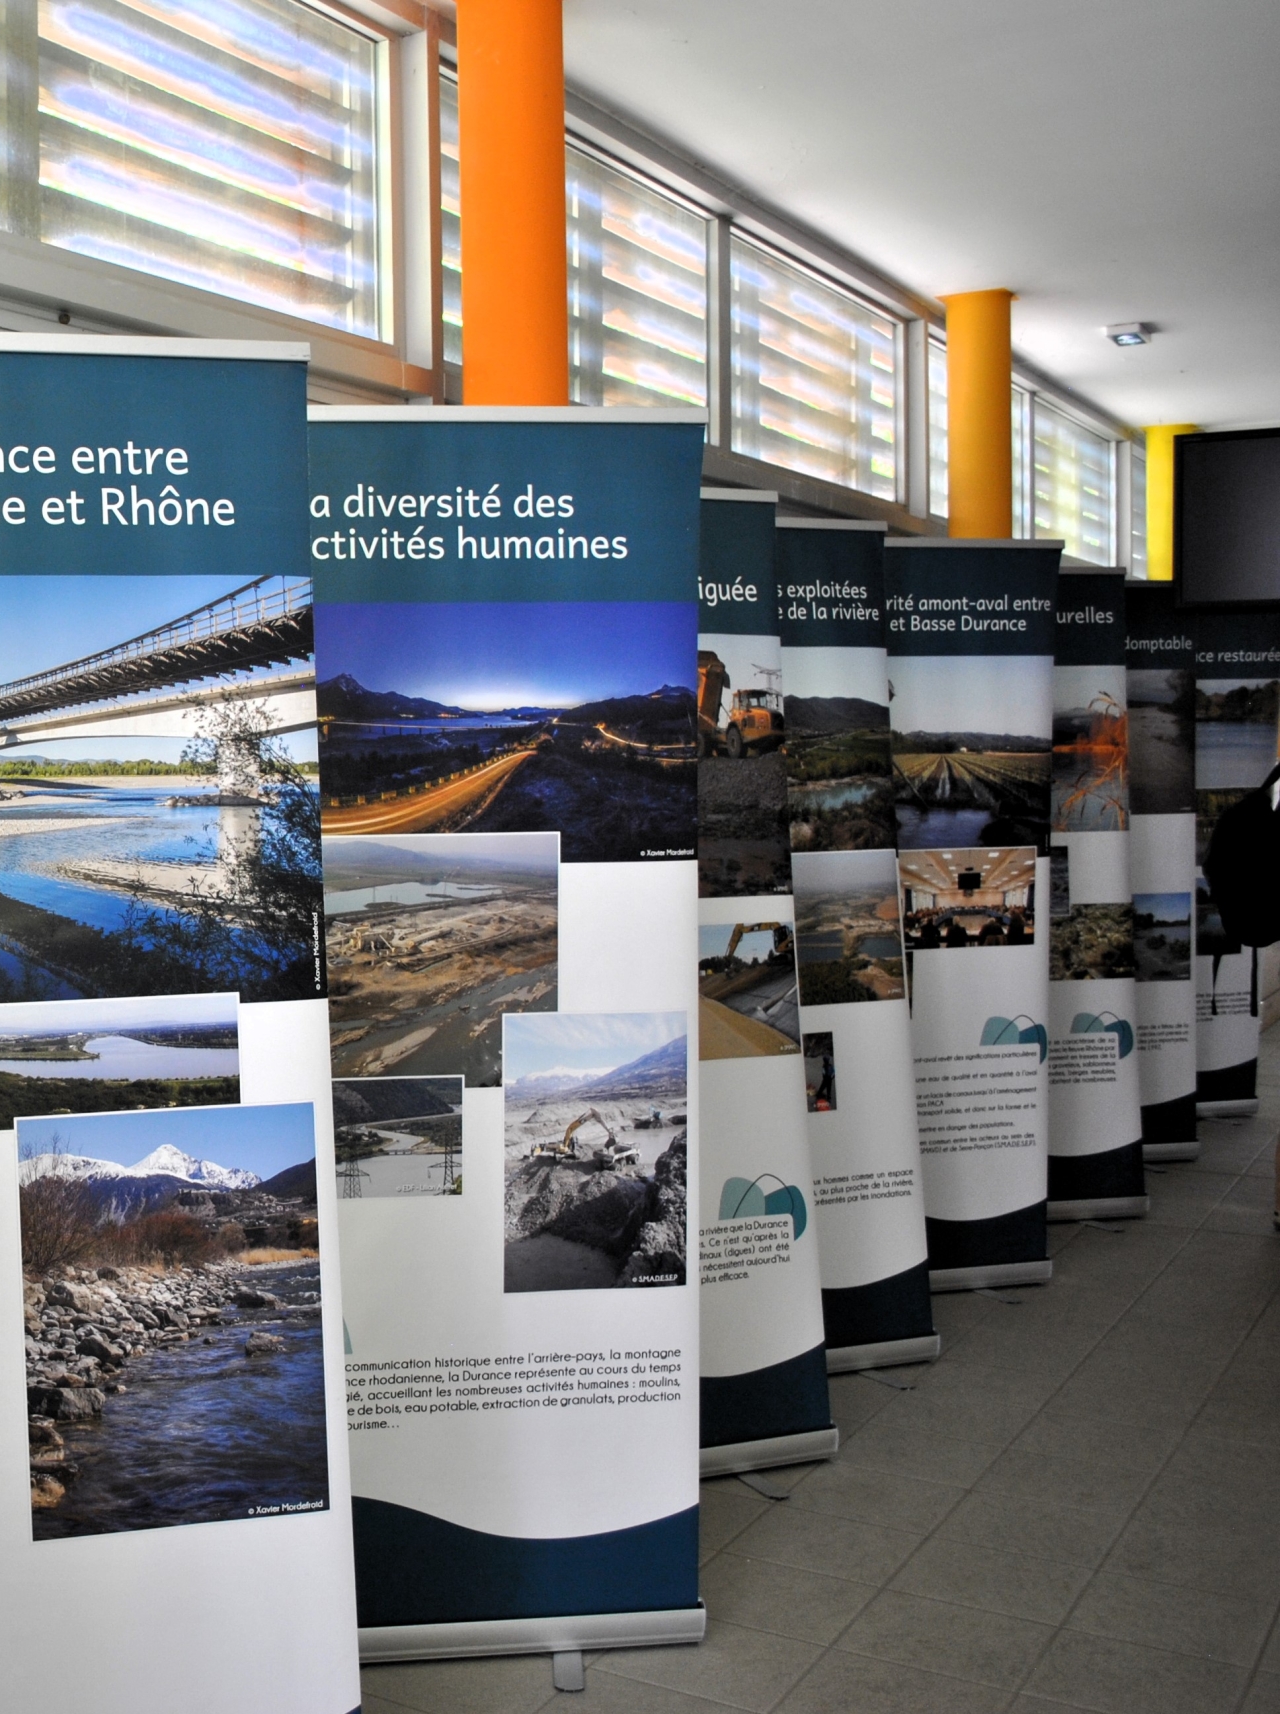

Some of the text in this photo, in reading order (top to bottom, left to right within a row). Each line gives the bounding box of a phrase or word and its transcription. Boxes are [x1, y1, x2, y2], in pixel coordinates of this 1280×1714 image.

[72, 441, 188, 475] entre
[42, 491, 86, 525] et
[101, 485, 235, 526] Rhône
[310, 484, 574, 518] a diversité des
[310, 525, 628, 560] ctivités humaines
[698, 576, 757, 606] iguée
[787, 580, 867, 602] exploitées
[788, 602, 807, 620] de
[812, 601, 827, 620] la
[832, 602, 879, 621] rivière
[886, 594, 1051, 611] rité amont-aval entre
[890, 615, 1026, 631] et Basse Durance
[1056, 606, 1114, 624] urelles
[1218, 647, 1280, 662] restaurée
[705, 1226, 728, 1236] rivière
[729, 1224, 744, 1234] que
[744, 1222, 752, 1230] la
[753, 1220, 788, 1230] Durance
[708, 1231, 789, 1247] Ce n'est qu'après la
[724, 1245, 755, 1257] (digues)
[758, 1244, 772, 1253] ont
[775, 1242, 790, 1252] été
[703, 1254, 790, 1272] nécessitent aujourd'hui
[700, 1272, 749, 1286] plus efficace.
[344, 1349, 681, 1372] communication historique entre l'arrière-pays, la montagne
[369, 1373, 444, 1386] rhodanienne,
[448, 1371, 460, 1382] la
[462, 1370, 512, 1382] Durance
[514, 1367, 576, 1380] représente
[579, 1368, 594, 1376] au
[596, 1366, 628, 1375] cours
[631, 1363, 646, 1374] du
[649, 1364, 681, 1374] temps
[367, 1387, 432, 1400] accueillant
[436, 1386, 452, 1397] les
[455, 1384, 522, 1396] nombreuses
[526, 1381, 574, 1393] activités
[578, 1380, 629, 1390] humaines
[639, 1376, 680, 1388] moulins,
[357, 1404, 373, 1416] de
[375, 1404, 402, 1414] bois,
[404, 1404, 428, 1413] eau
[430, 1400, 479, 1414] potable,
[482, 1398, 540, 1410] extraction
[542, 1396, 558, 1407] de
[560, 1393, 615, 1407] granulats,
[618, 1392, 681, 1405] production
[255, 1505, 280, 1515] Xavier
[281, 1499, 323, 1512] Mordefroid
